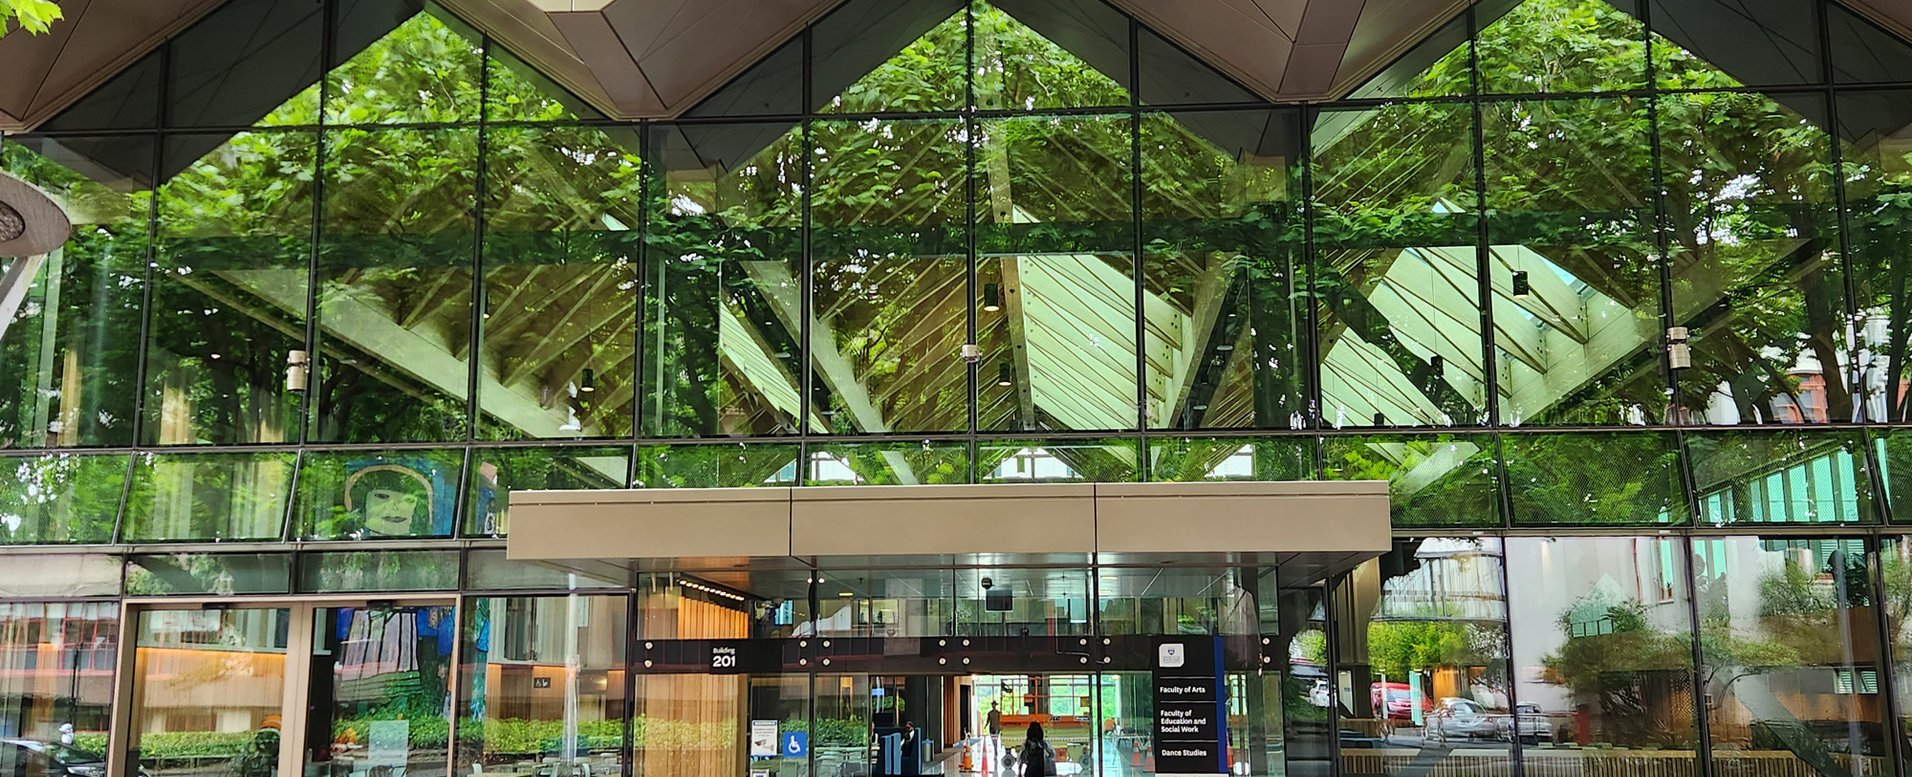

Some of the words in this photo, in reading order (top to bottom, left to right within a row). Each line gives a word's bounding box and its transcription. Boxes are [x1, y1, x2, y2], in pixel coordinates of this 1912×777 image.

[713, 647, 735, 655] Building
[713, 655, 735, 667] 201
[1160, 686, 1183, 695] Faculty
[1161, 710, 1184, 718] Faculty
[1185, 709, 1192, 717] of
[1194, 717, 1206, 725] and
